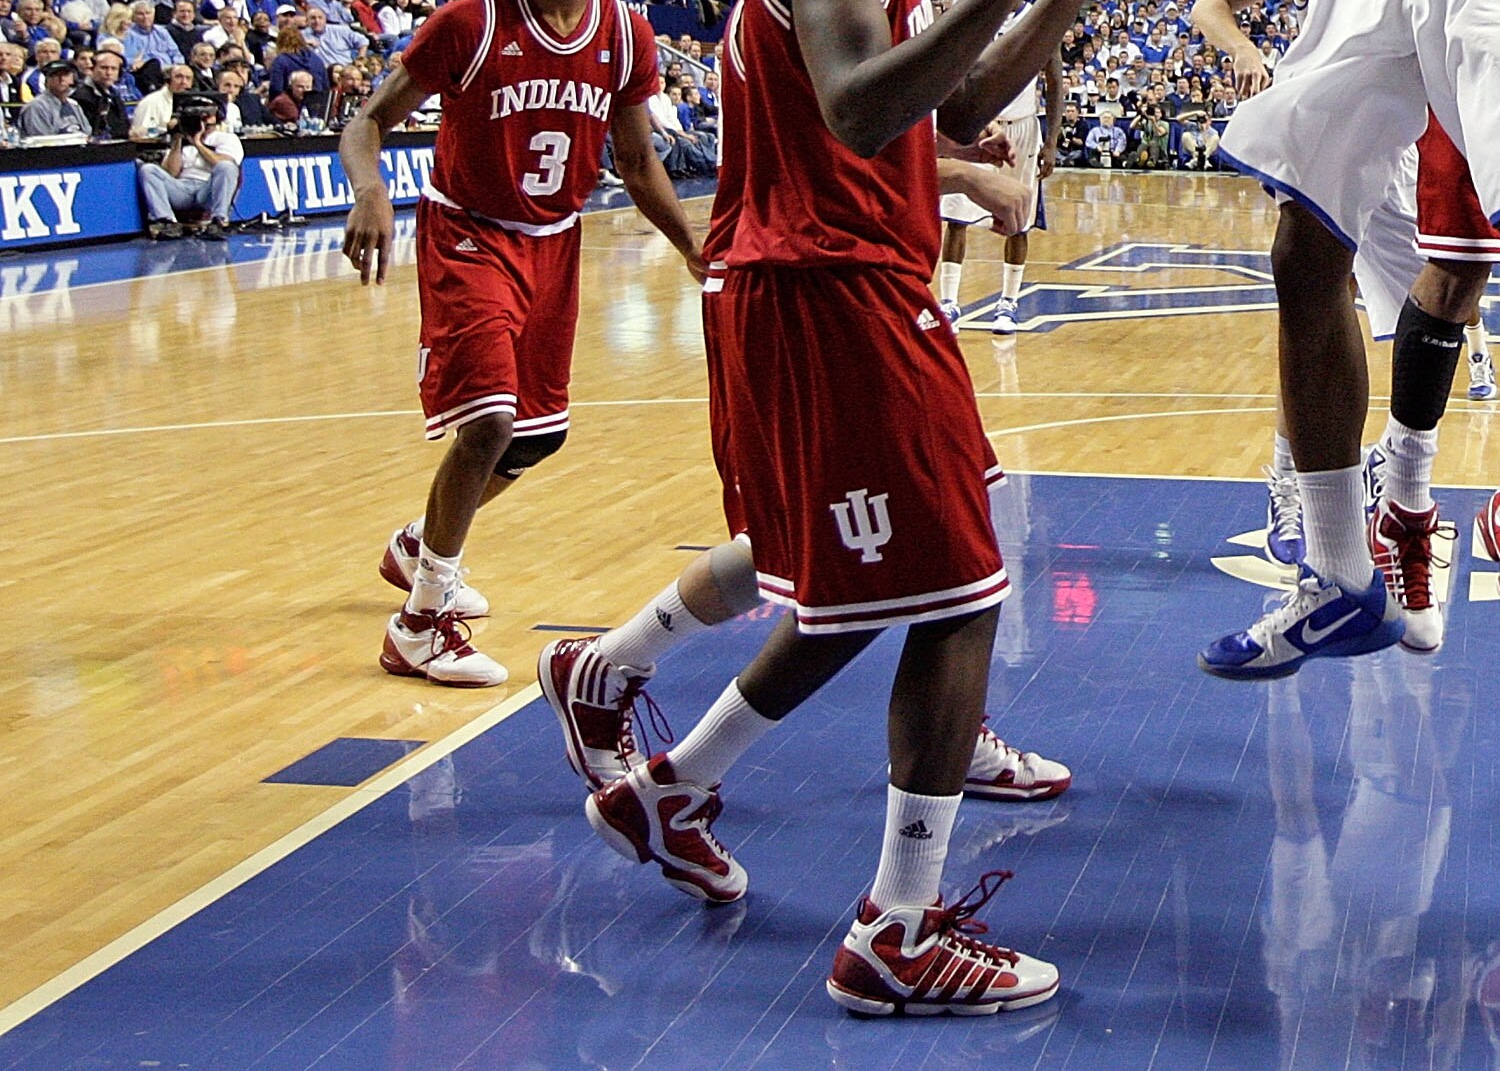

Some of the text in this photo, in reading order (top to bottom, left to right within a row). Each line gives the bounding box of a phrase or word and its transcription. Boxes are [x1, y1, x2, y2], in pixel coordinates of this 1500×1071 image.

[490, 79, 612, 122] INDIANA
[259, 148, 434, 212] WILCAT
[522, 131, 571, 197] 3
[0, 172, 81, 241] KY
